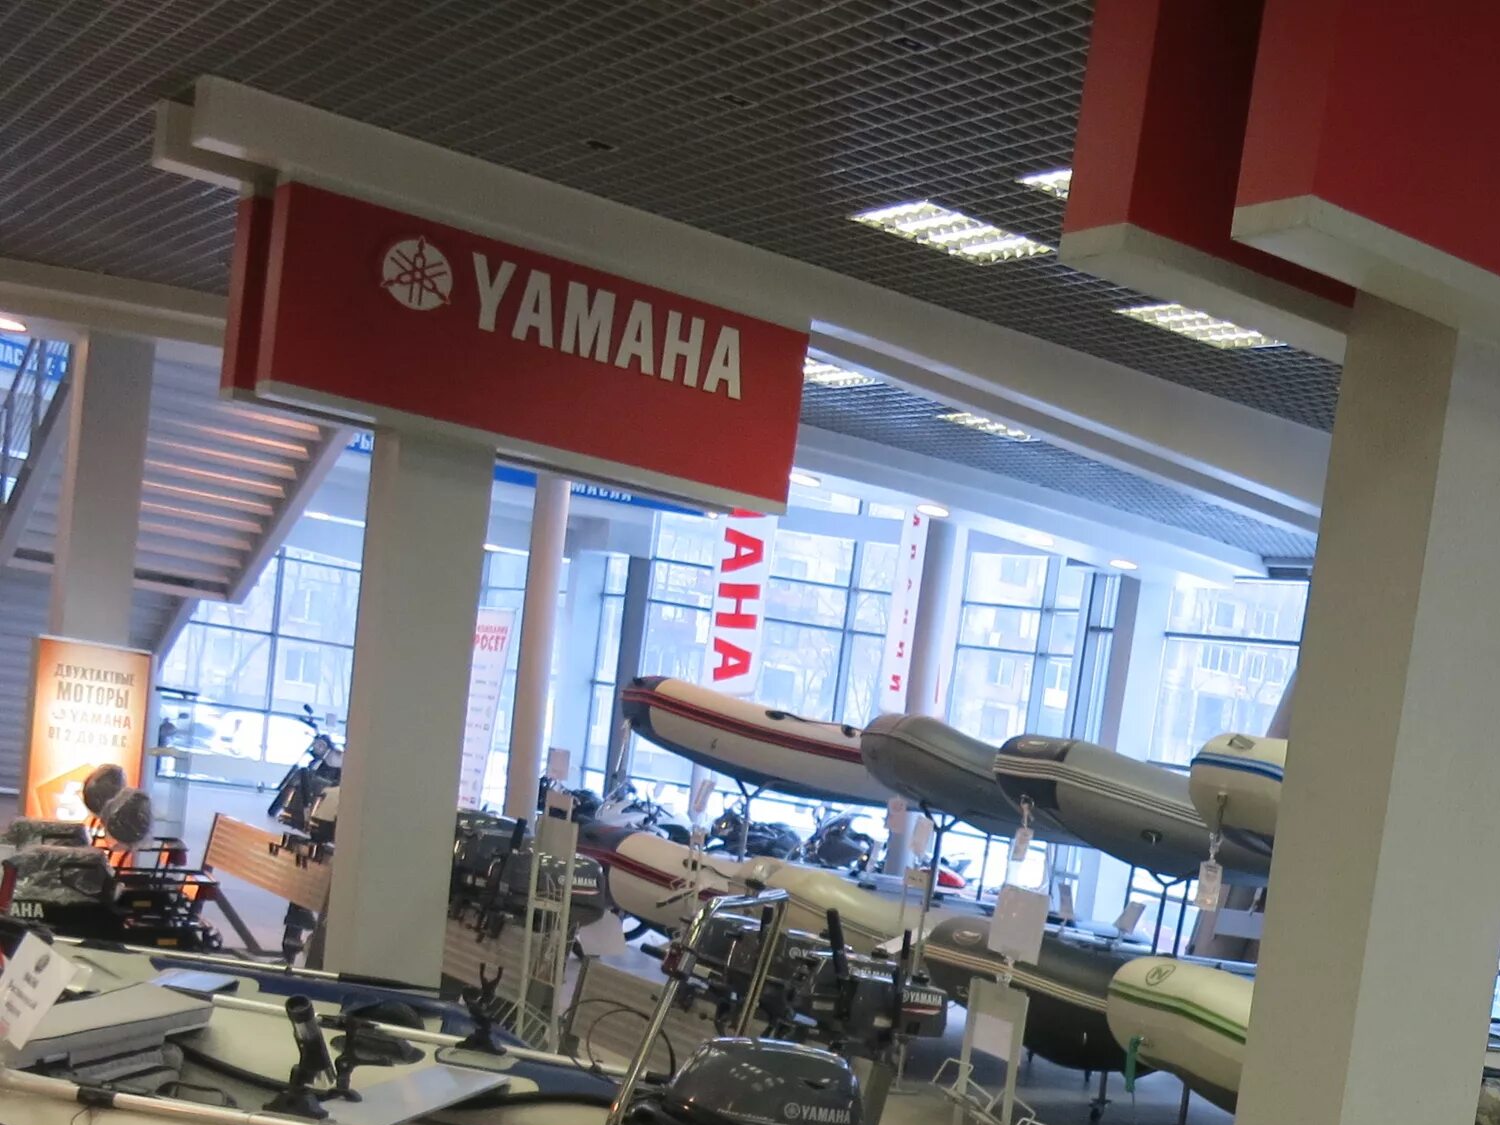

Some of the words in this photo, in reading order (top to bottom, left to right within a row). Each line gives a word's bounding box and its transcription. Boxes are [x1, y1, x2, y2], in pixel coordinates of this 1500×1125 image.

[472, 251, 742, 400] YAMAHA
[713, 509, 767, 682] AHA
[56, 680, 130, 709] МОТОРЫ
[70, 709, 132, 730] YAMAHA
[909, 992, 943, 1007] YAMAHA
[802, 1105, 851, 1124] YAMAHA
